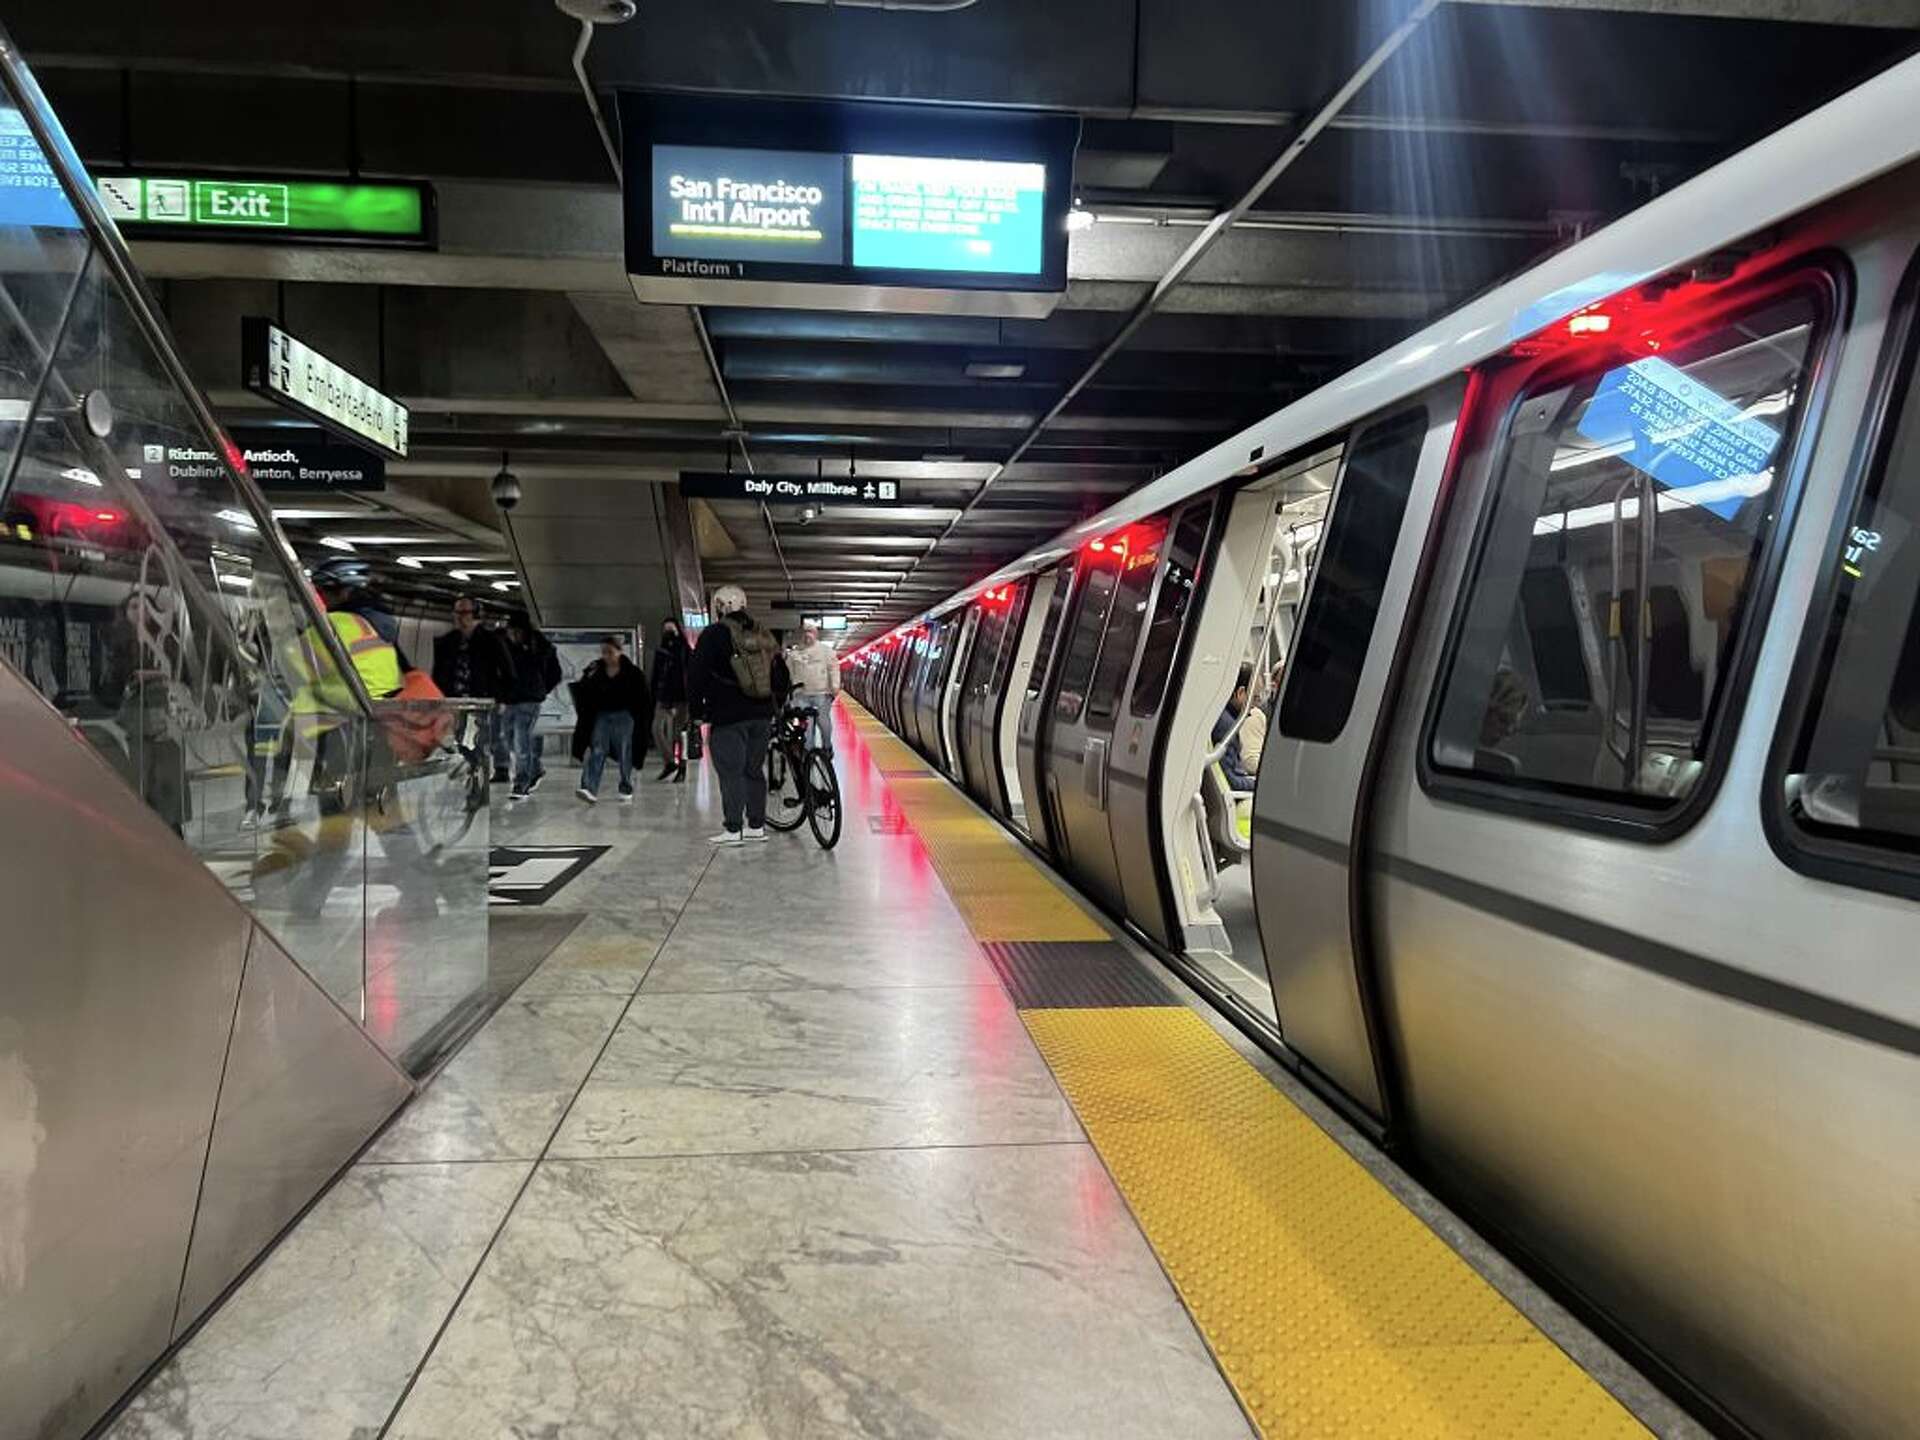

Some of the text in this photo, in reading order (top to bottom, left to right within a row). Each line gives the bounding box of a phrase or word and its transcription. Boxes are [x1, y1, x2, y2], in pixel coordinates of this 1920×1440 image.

[669, 175, 823, 205] San Francisco
[211, 189, 271, 217] Exit
[681, 200, 811, 228] Int'l Airport
[662, 259, 744, 276] Platform 1
[305, 362, 384, 431] Embarcadero
[242, 449, 300, 463] Antioch,
[299, 467, 363, 482] Berryessa
[744, 480, 773, 494] Daly
[776, 481, 804, 496] City,
[807, 482, 858, 496] Millbrae
